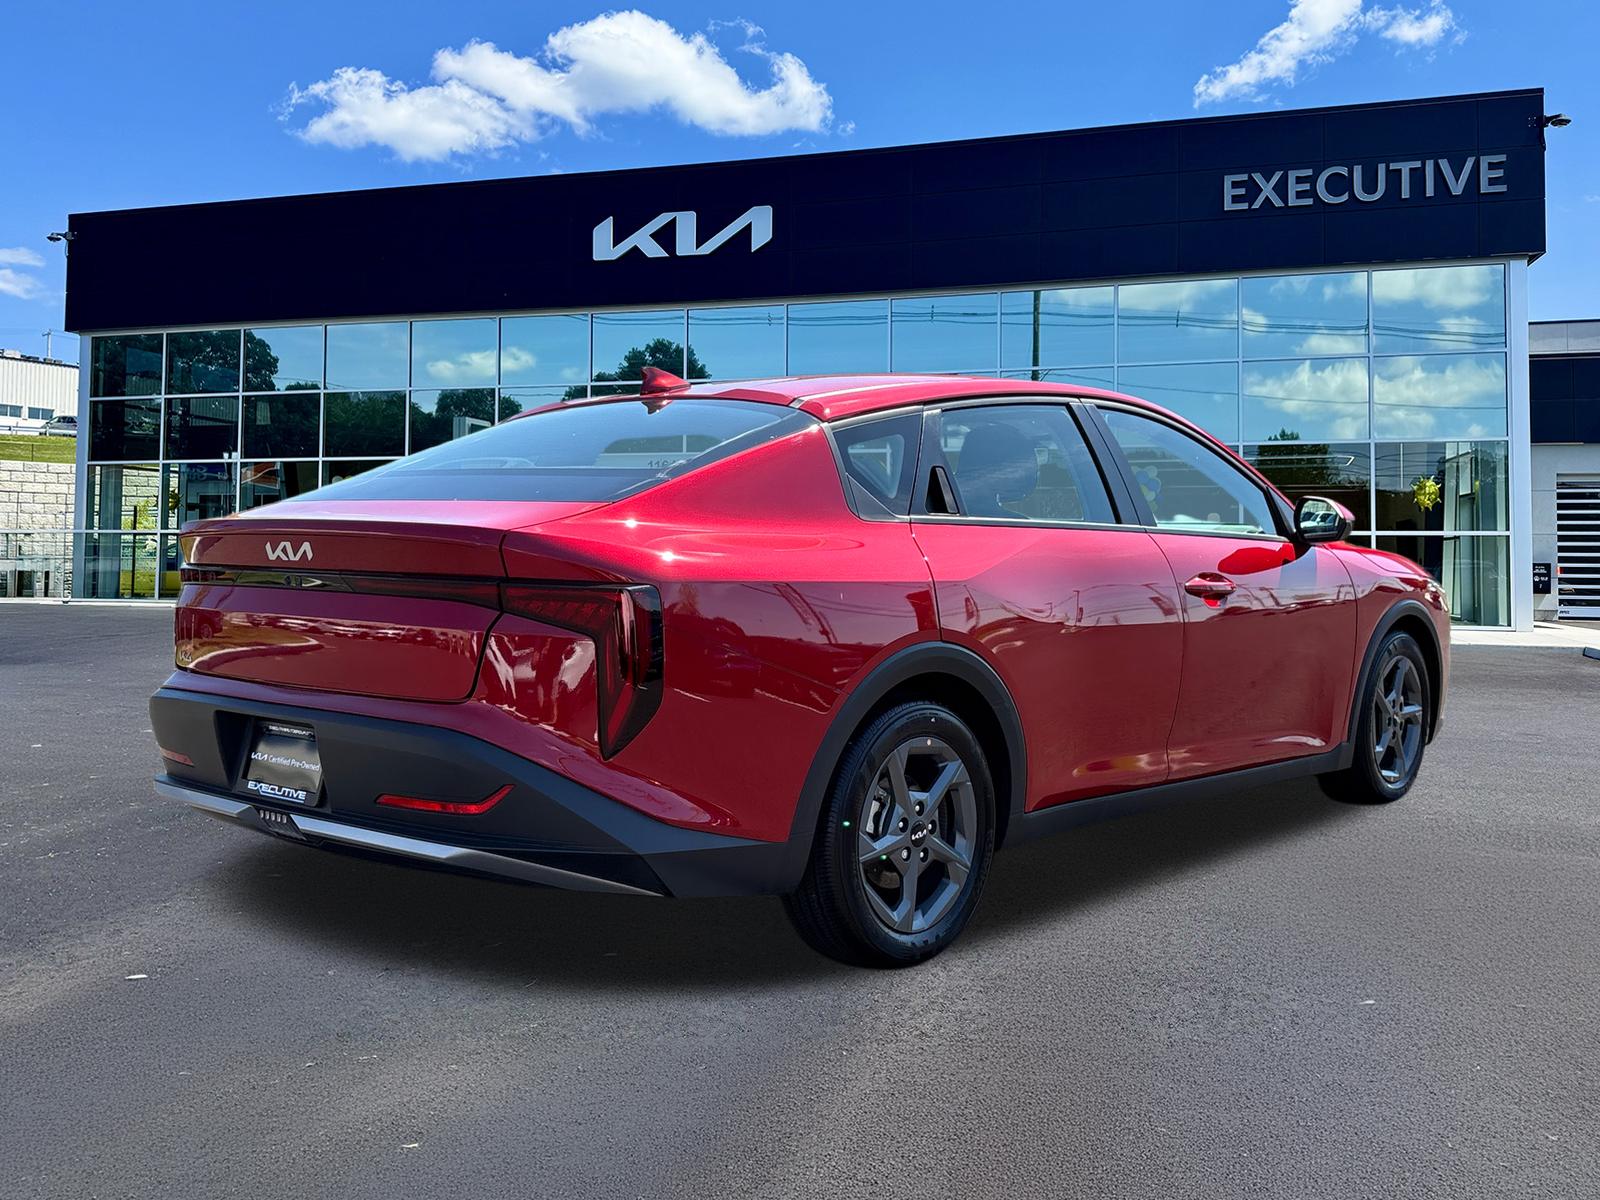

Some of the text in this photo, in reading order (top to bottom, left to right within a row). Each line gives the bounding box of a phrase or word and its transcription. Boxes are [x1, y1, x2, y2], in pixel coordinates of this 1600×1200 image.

[1223, 154, 1508, 212] EXECUTIVE
[592, 205, 773, 261] KIA
[265, 541, 313, 561] KIA
[250, 752, 320, 771] KIA Certified Pre-Owned
[247, 780, 307, 800] EXECUTIVE
